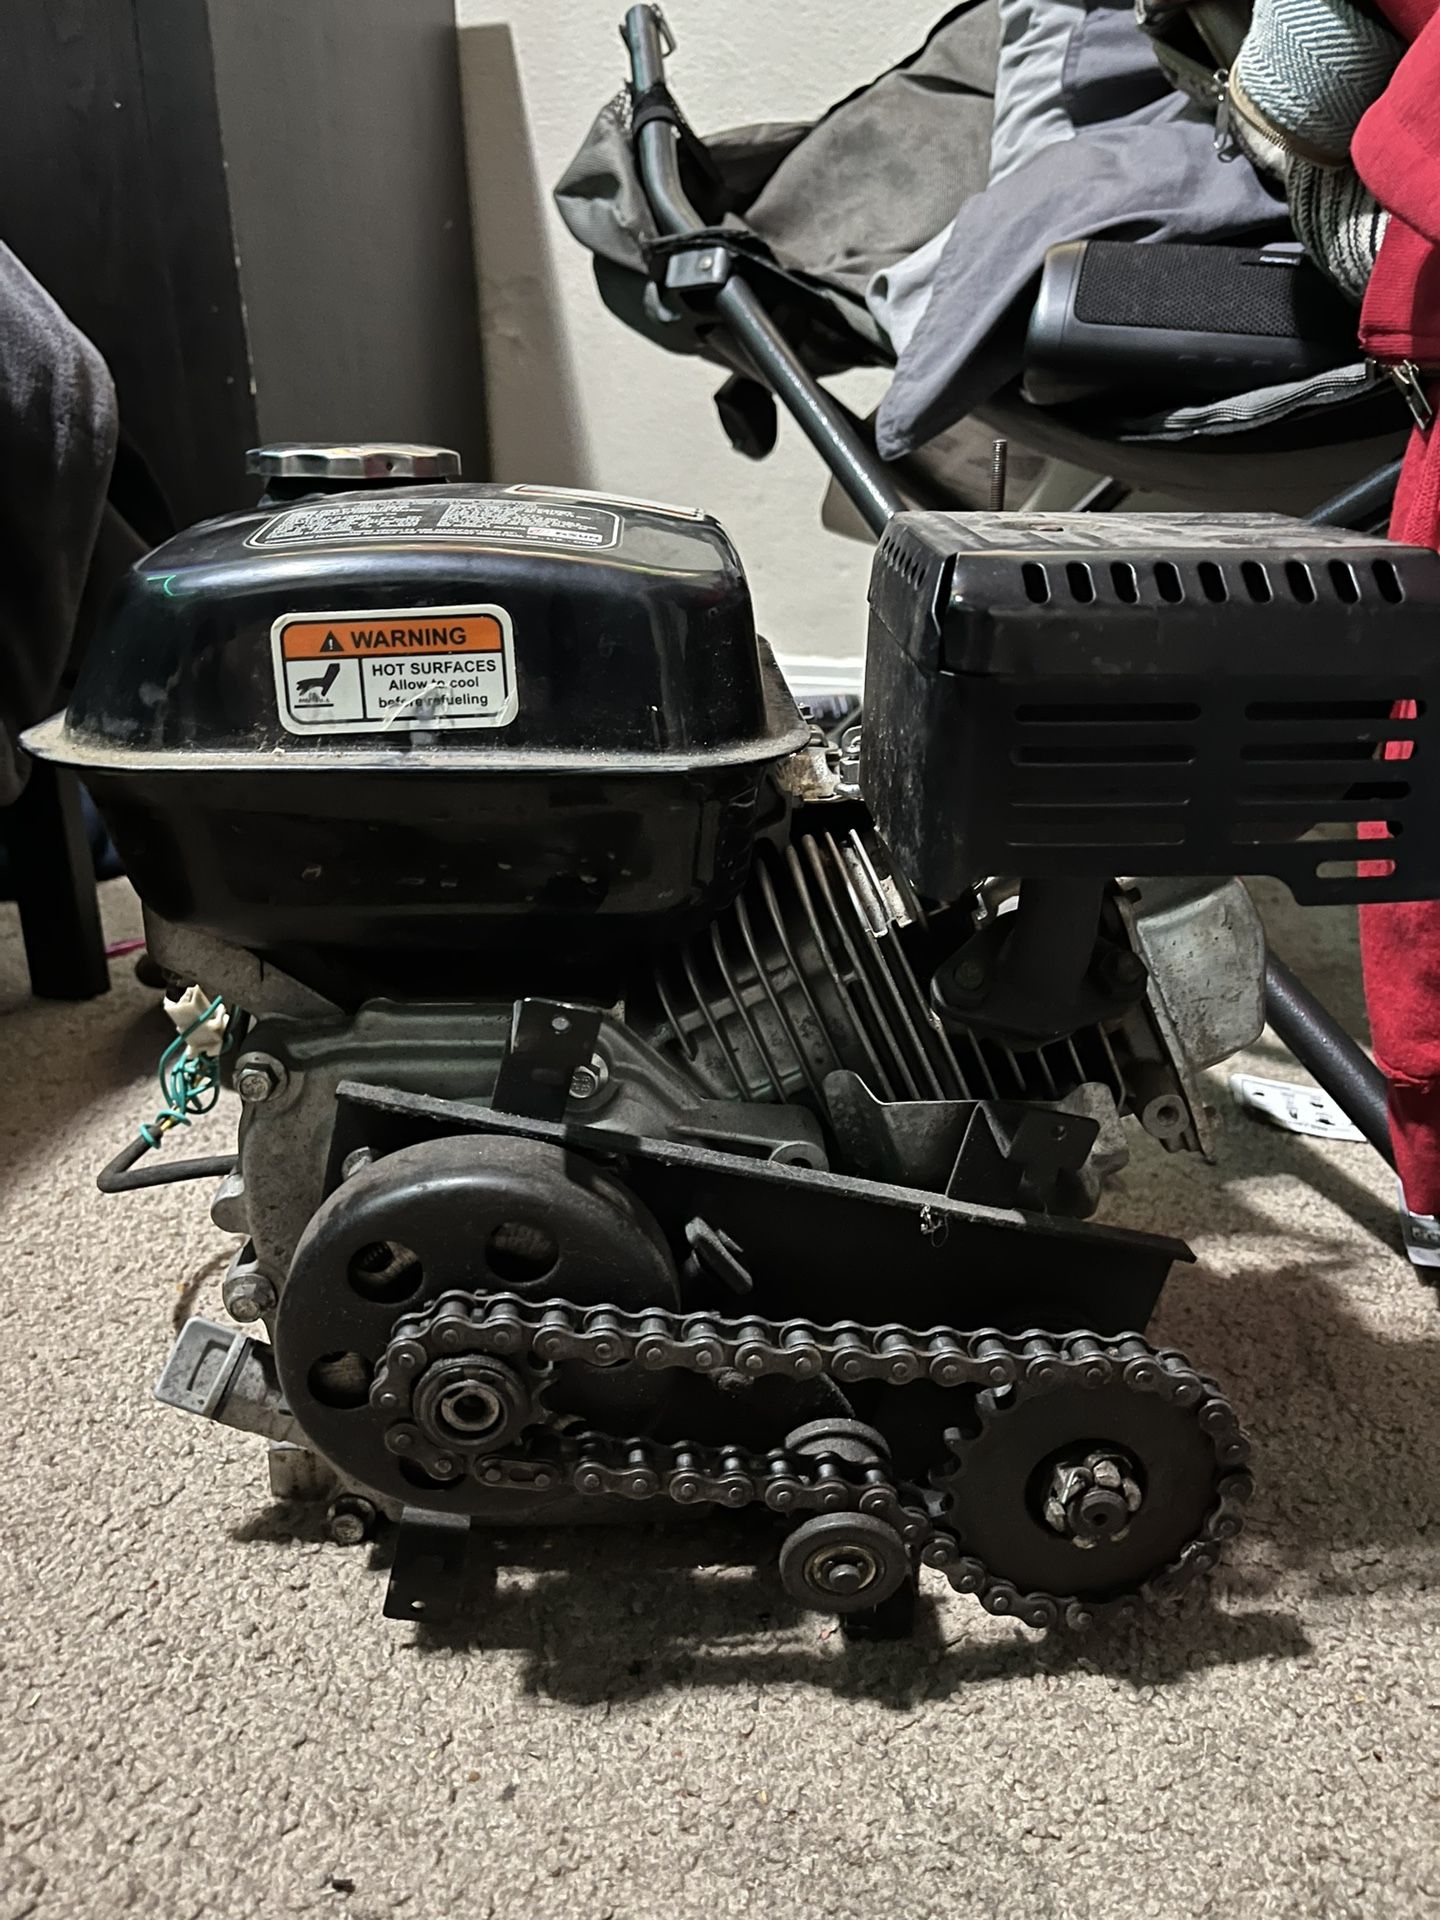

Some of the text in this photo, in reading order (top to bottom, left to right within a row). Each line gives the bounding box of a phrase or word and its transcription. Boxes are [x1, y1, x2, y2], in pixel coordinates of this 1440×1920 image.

[350, 627, 467, 649] WARNING
[372, 659, 497, 677] HOT SURFACES
[389, 679, 428, 691] Allow
[449, 676, 479, 688] cool
